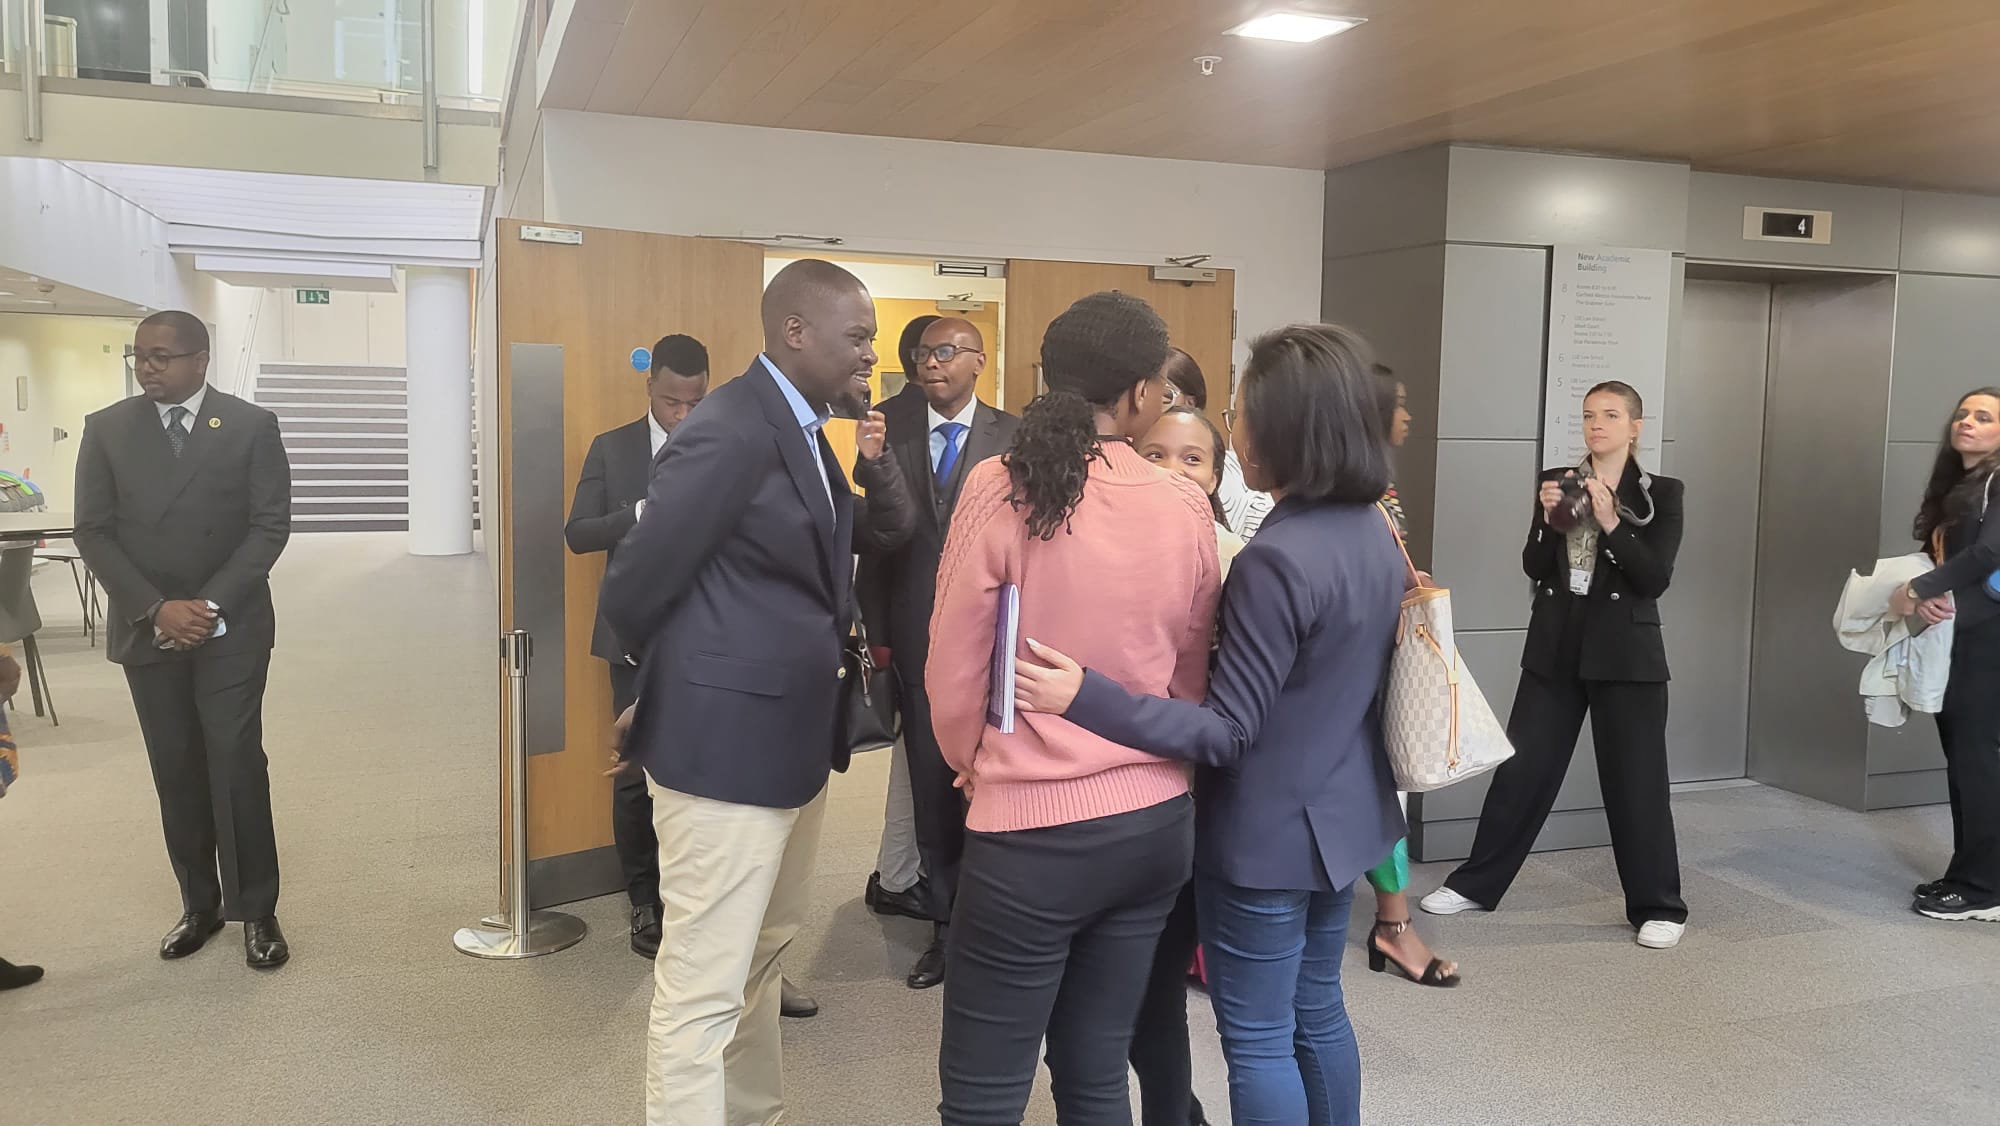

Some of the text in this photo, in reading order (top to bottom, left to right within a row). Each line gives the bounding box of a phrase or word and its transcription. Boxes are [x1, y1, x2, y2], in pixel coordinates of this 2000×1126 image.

[1798, 218, 1805, 234] 4
[1577, 252, 1631, 263] New Academic
[1577, 263, 1607, 273] Building
[1561, 283, 1568, 293] 8
[1560, 314, 1566, 324] 7
[1558, 353, 1565, 362] 6
[1557, 377, 1563, 388] 5
[1555, 416, 1560, 424] 4
[1554, 446, 1559, 456] 3
